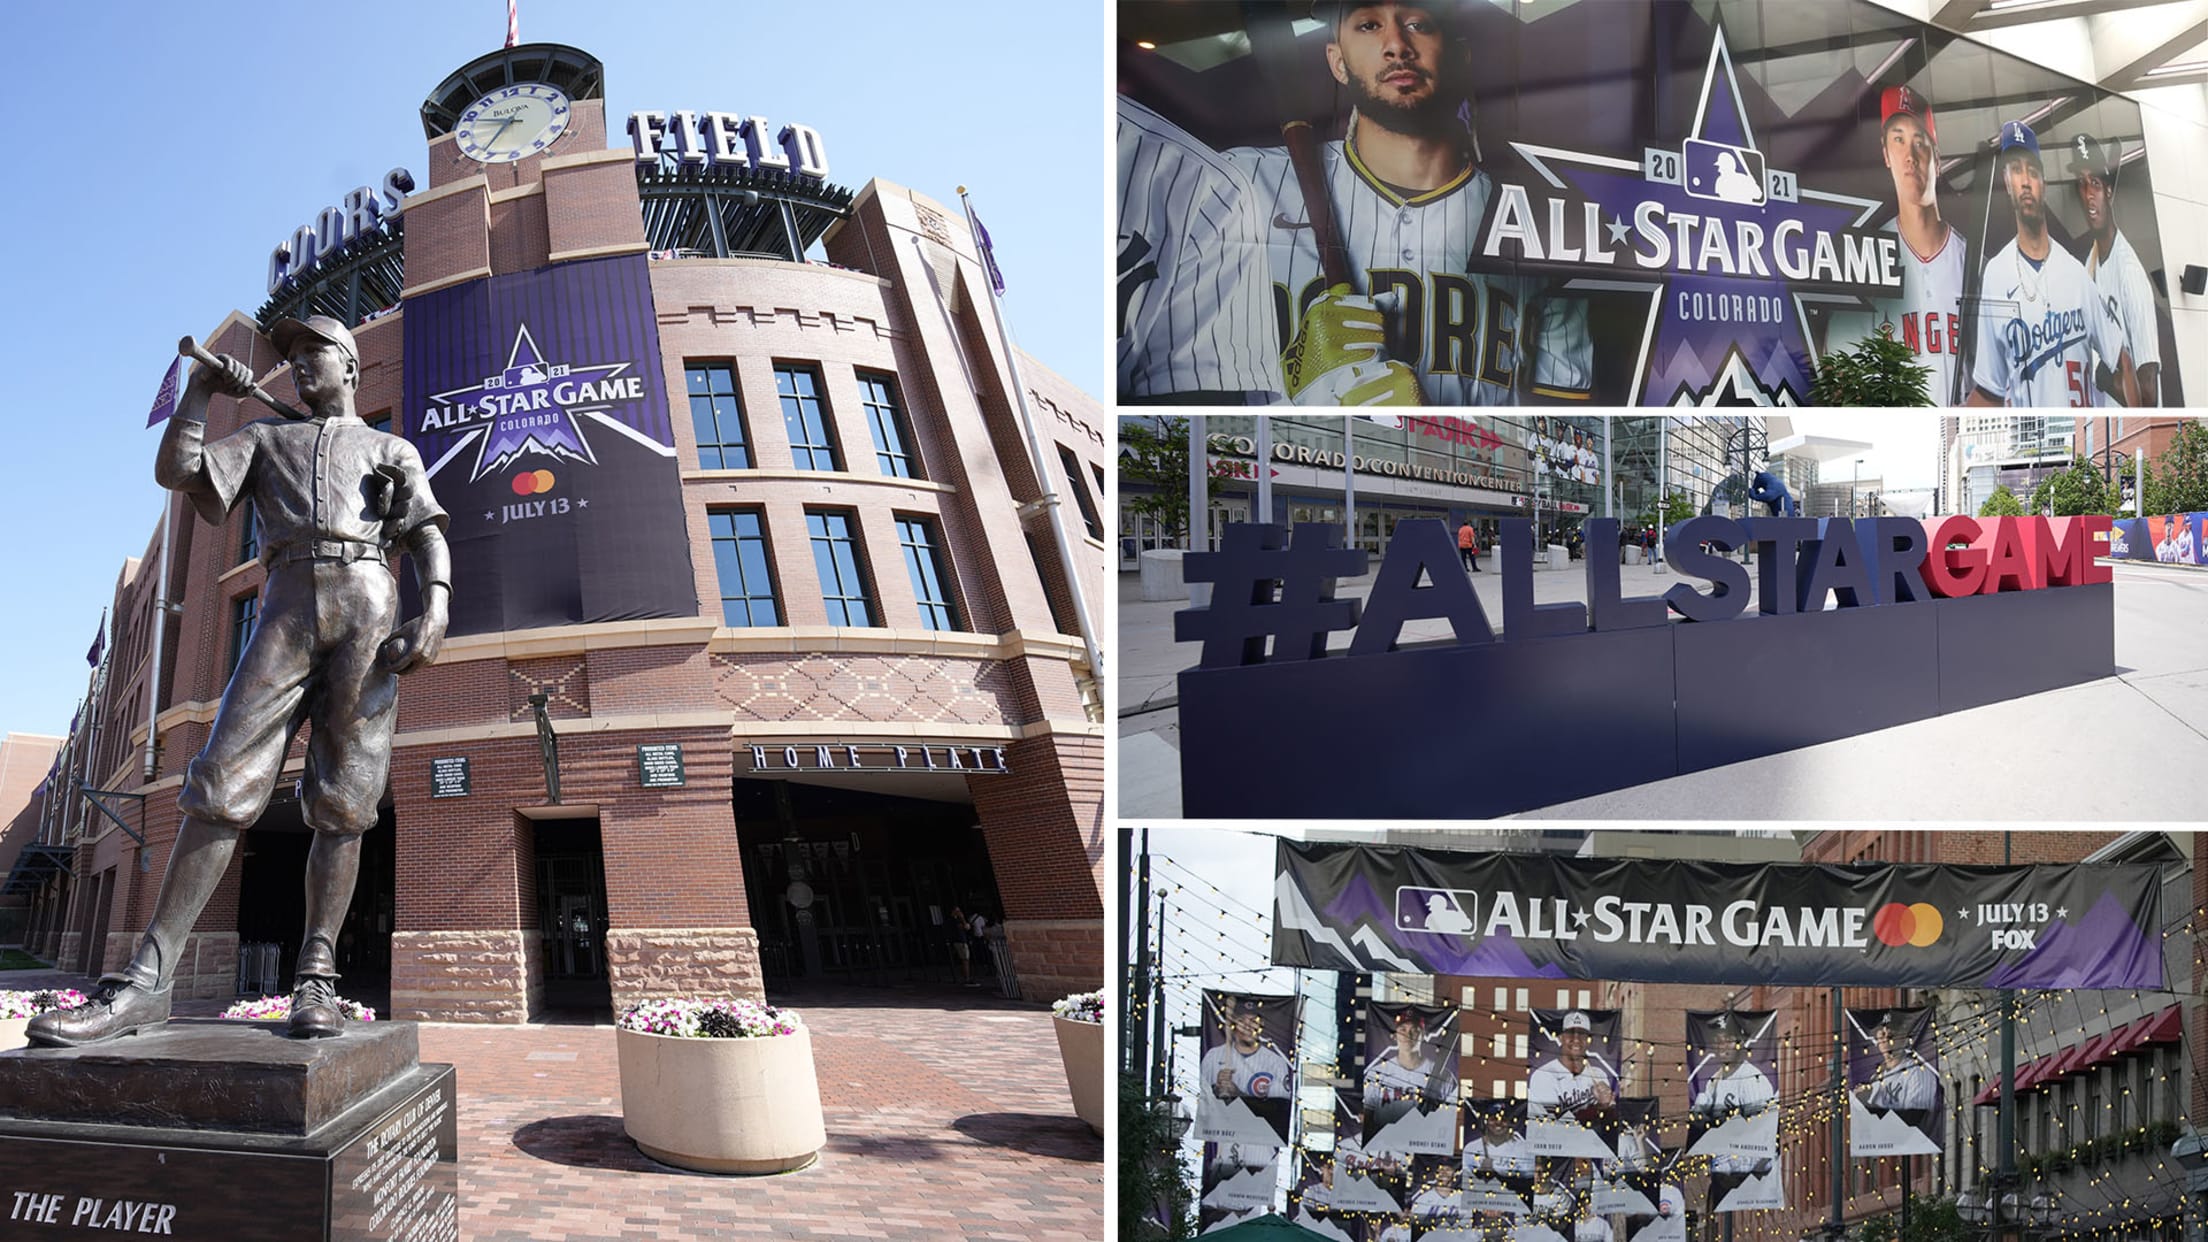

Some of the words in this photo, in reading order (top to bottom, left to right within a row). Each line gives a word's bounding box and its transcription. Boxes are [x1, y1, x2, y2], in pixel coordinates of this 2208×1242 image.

[501, 87, 519, 97] 12
[529, 86, 538, 94] 1
[545, 92, 559, 102] 2
[479, 97, 494, 107] 11
[493, 104, 528, 117] BULOVA
[555, 106, 567, 115] 3
[463, 110, 478, 122] 10
[459, 130, 470, 138] 9
[550, 124, 561, 133] 4
[465, 143, 477, 153] 8
[508, 150, 520, 159] 6
[533, 139, 544, 149] 5
[626, 110, 830, 180] FIELD
[484, 151, 496, 160] 7
[1652, 153, 1676, 180] 20
[1772, 174, 1791, 198] 21
[268, 167, 415, 296] COORS
[1483, 183, 1615, 264] ALL
[1633, 200, 1772, 277] STAR
[1773, 218, 1901, 287] GAME
[1678, 291, 1783, 324] COLORADO
[2006, 308, 2086, 368] Dodgers
[487, 378, 500, 387] 20
[421, 403, 472, 432] ALL
[478, 388, 551, 419] STAR
[553, 377, 644, 405] GAME
[500, 413, 559, 432] COLORADO
[1207, 432, 1364, 470] COORADO
[1370, 457, 1481, 486] CONVENTION
[1481, 475, 1522, 493] CENTER
[502, 500, 546, 525] JULY
[551, 498, 570, 514] 13
[1174, 514, 2113, 667] #ALLSTARGAME
[751, 745, 862, 769] HOME
[893, 744, 1008, 771] PLATE
[1484, 890, 1579, 940] ALL
[1593, 895, 1717, 946] STAR
[1721, 899, 1868, 949] GAME
[1976, 903, 2025, 927] JULY
[2028, 902, 2050, 922] 13
[1991, 929, 2037, 951] FOX
[10, 1191, 65, 1225] THE
[71, 1196, 177, 1236] PLAYER
